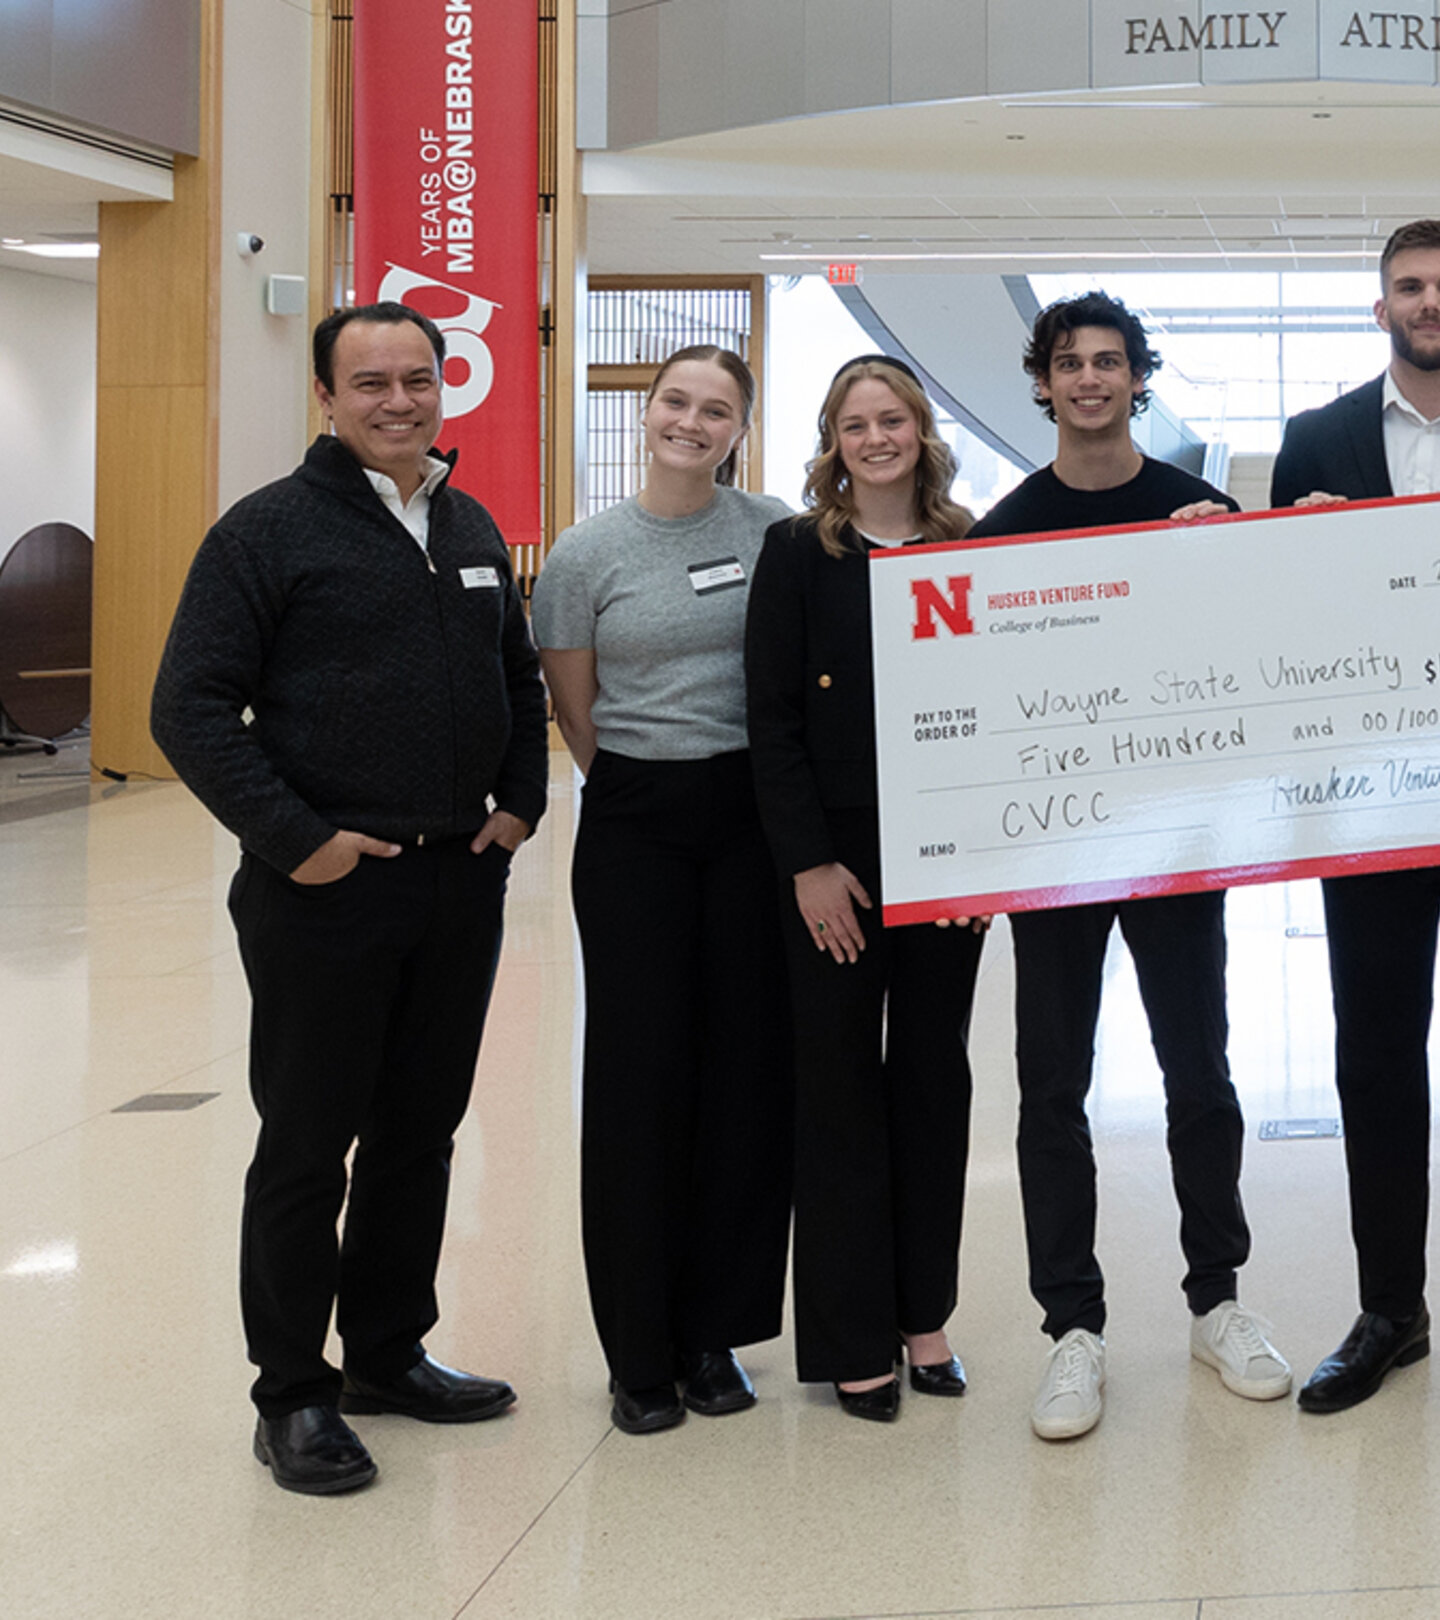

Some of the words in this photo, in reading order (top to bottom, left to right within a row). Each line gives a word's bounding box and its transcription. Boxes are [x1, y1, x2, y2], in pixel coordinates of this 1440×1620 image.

[1124, 11, 1288, 55] FAMILY
[419, 127, 442, 163] OF
[419, 172, 443, 257] YEARS
[828, 263, 856, 285] EXIT
[987, 591, 1037, 611] HUSKER
[1039, 584, 1094, 605] VENTURE
[1097, 580, 1130, 599] FUND
[1389, 576, 1417, 591] DATE
[909, 573, 974, 641] N
[989, 619, 1033, 636] College
[1034, 616, 1048, 633] of
[1050, 612, 1101, 629] Business
[1016, 683, 1129, 725] Wayne
[1149, 664, 1240, 705] State
[1259, 644, 1401, 690] University
[1424, 660, 1437, 684] $
[914, 711, 935, 726] PAY
[937, 709, 952, 724] TO
[954, 706, 977, 722] THE
[914, 726, 959, 742] ORDER
[962, 723, 978, 738] OF
[1017, 743, 1090, 776] Five
[1112, 717, 1246, 765] Hundred
[1291, 717, 1335, 742] and
[1268, 766, 1375, 813] Husker
[1001, 791, 1111, 839] CVCC
[918, 843, 957, 858] MEMO
